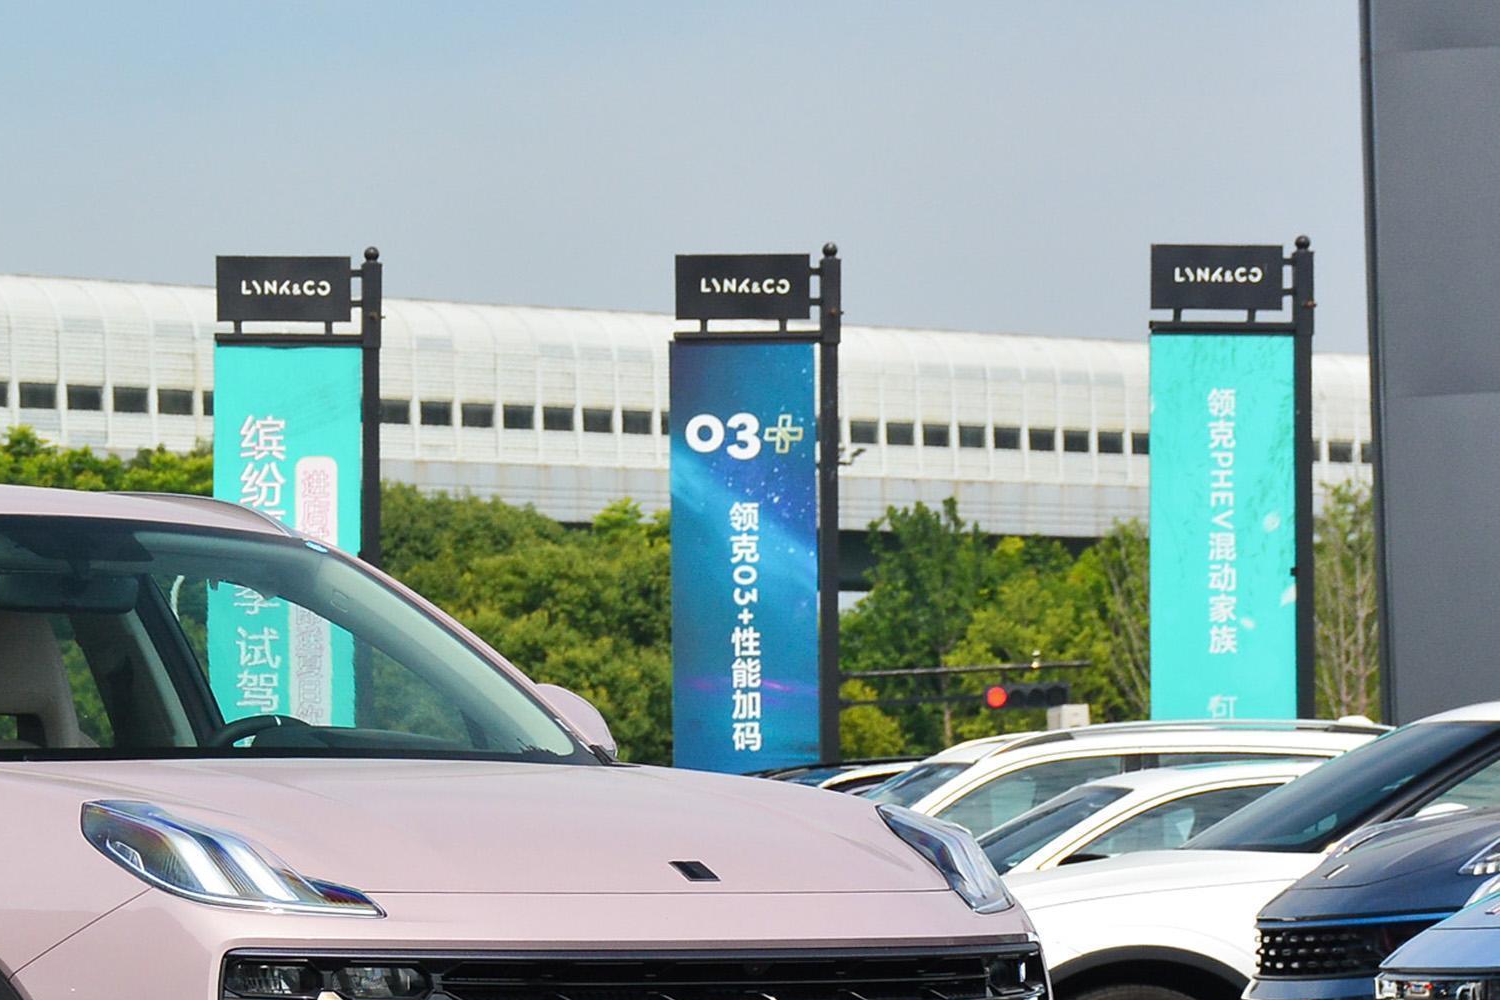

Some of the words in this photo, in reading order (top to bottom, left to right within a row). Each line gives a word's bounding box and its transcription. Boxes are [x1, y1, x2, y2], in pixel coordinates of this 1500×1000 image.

[1174, 266, 1264, 284] LYNK&CO
[241, 279, 332, 296] LYNK&CO
[700, 277, 791, 295] LYNK&CO
[1207, 387, 1238, 655] 领克PHEV混动家族
[728, 501, 762, 752] 领克03+性能加码
